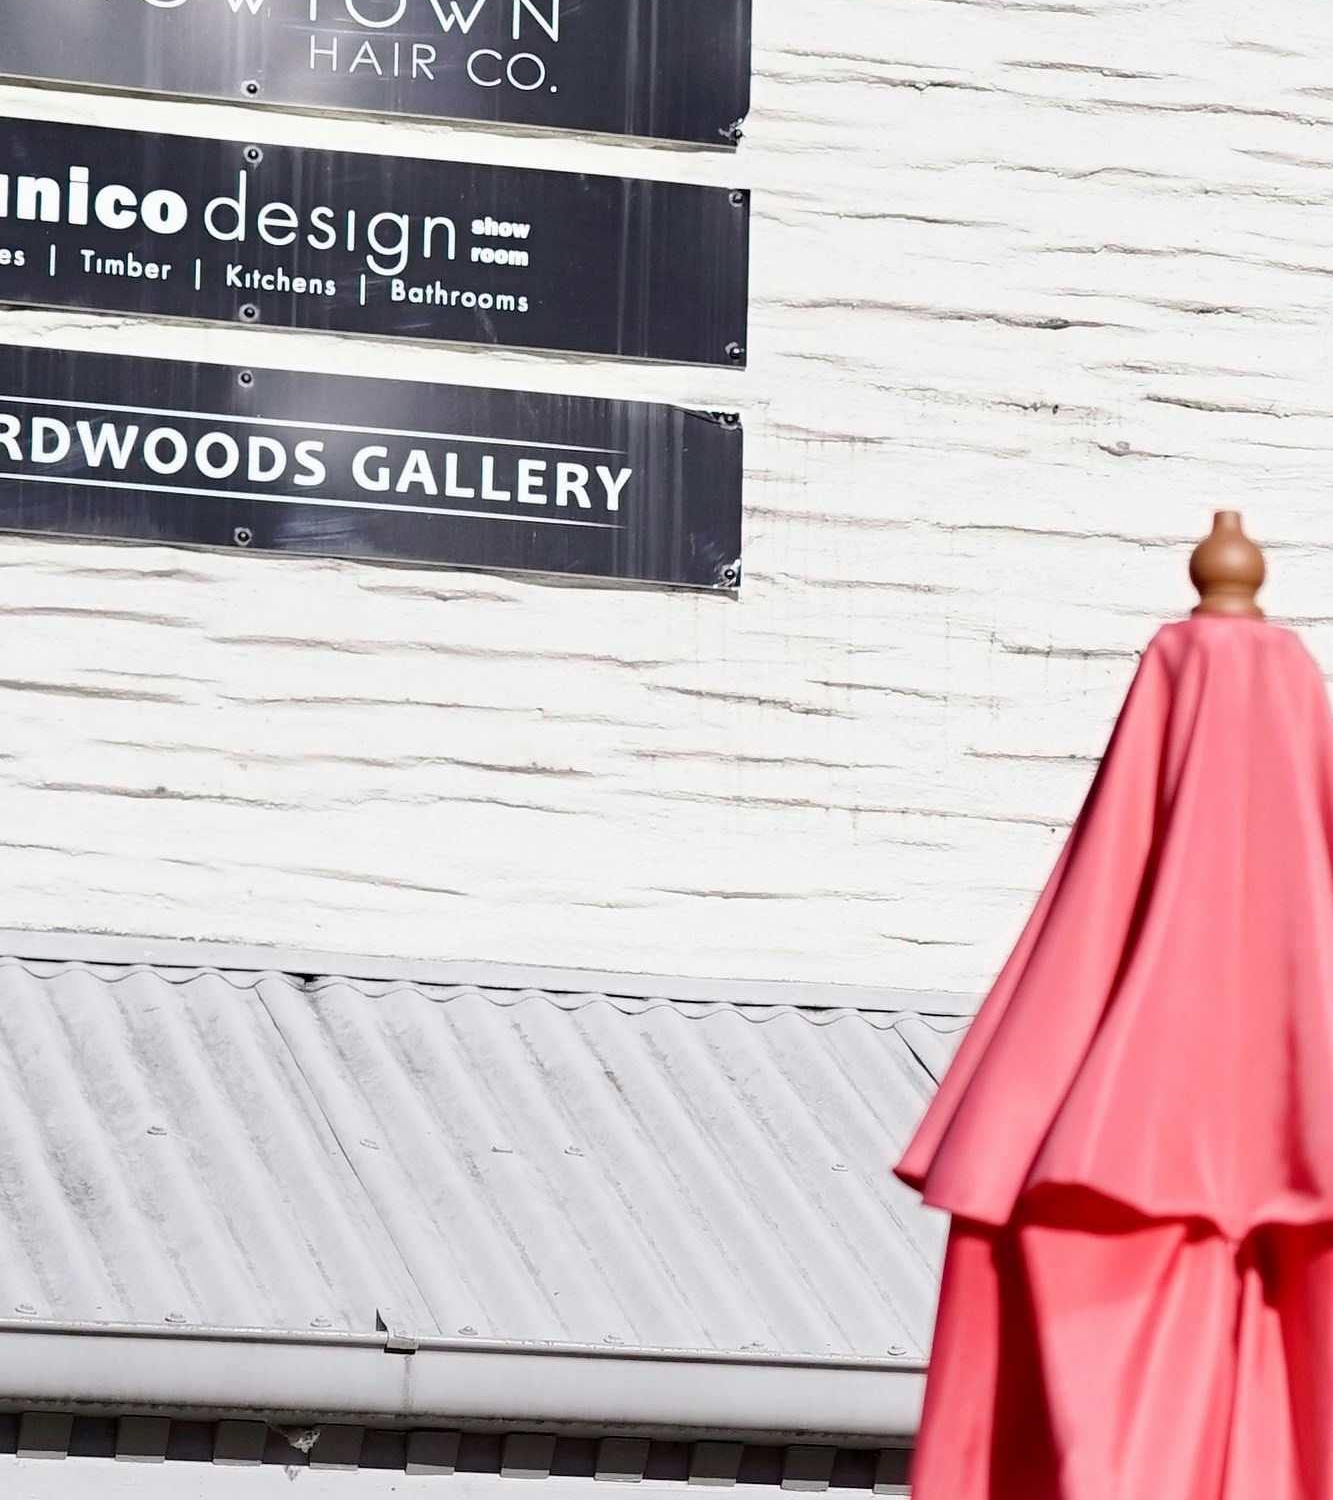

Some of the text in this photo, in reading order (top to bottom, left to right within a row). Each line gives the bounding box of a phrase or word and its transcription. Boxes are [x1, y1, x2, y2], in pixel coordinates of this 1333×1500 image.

[308, 37, 560, 94] HAIR CO.
[202, 168, 457, 276] design
[471, 216, 530, 239] show
[81, 249, 172, 281] Timber
[226, 266, 337, 298] Kitchens
[390, 279, 530, 312] Bathrooms
[470, 247, 529, 267] room
[0, 413, 633, 512] RDWOODS GALLERY
